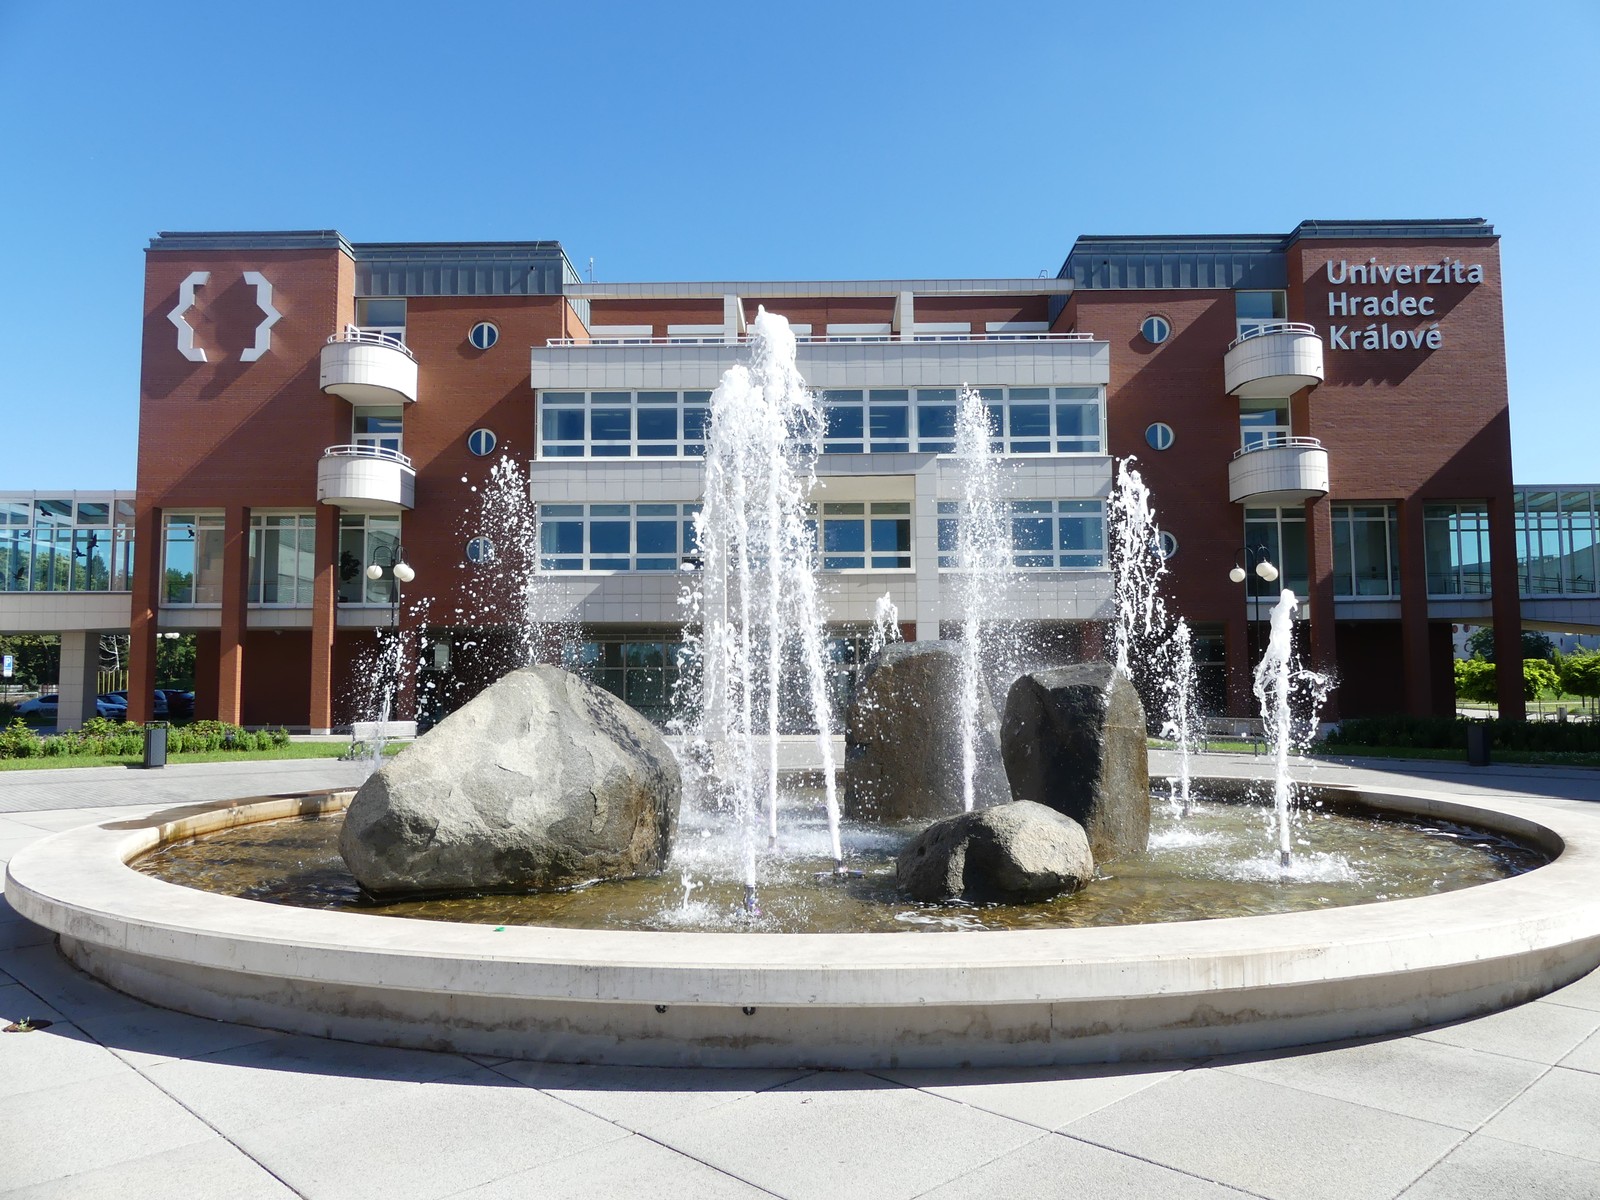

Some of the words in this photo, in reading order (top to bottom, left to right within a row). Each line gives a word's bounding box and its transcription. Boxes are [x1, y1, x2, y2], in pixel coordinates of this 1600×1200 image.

[1326, 257, 1484, 284] Univerzita
[1328, 289, 1435, 316] Hradec
[1330, 323, 1443, 350] Králové
